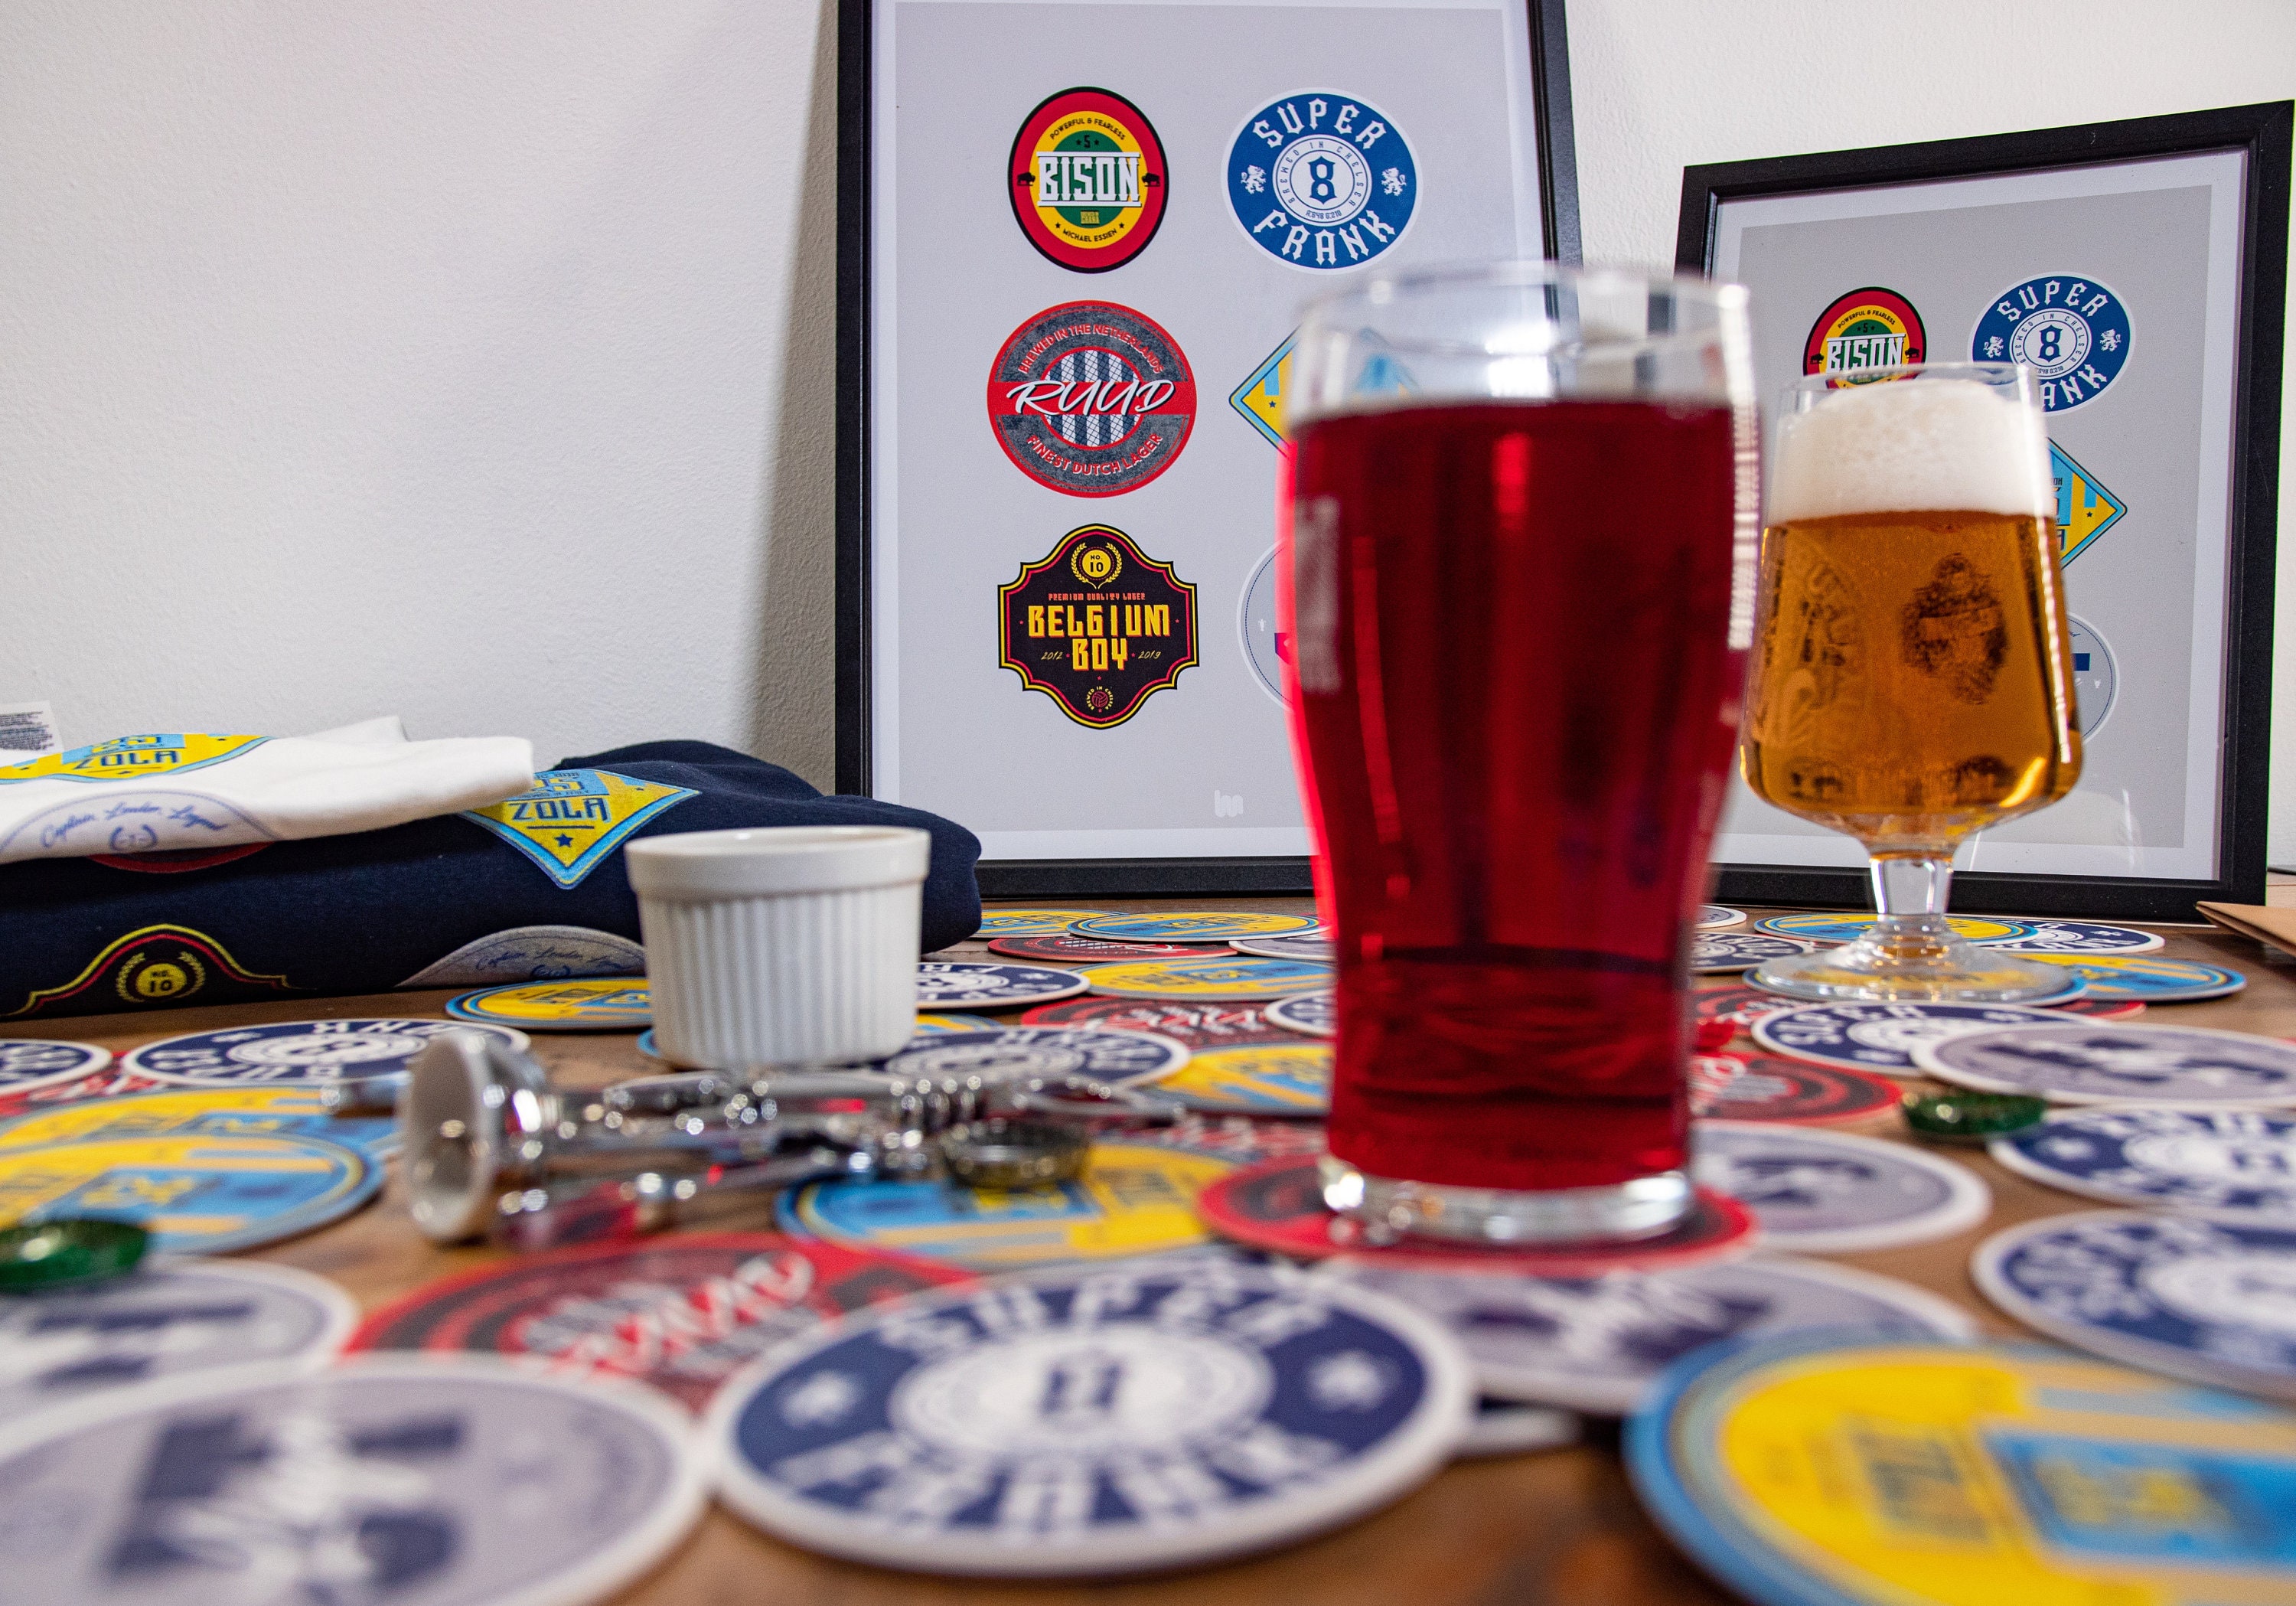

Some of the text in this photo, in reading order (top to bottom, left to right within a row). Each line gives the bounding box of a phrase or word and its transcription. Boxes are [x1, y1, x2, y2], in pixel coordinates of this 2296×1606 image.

[1050, 118, 1085, 140] POWERFUL
[1094, 118, 1125, 140] FEARLESS
[1252, 97, 1387, 149] SUPER
[1084, 135, 1091, 149] 5
[1038, 155, 1140, 202] BISON
[1307, 155, 1338, 204] 8
[1063, 228, 1117, 242] MICHAEL ESSIEN
[1253, 209, 1396, 266] FRANK
[1997, 279, 2108, 322] SUPER
[1838, 310, 1865, 328] POWERFUL
[1872, 309, 1896, 325] FEARLESS
[1863, 323, 1868, 333] 5
[1017, 324, 1164, 374] BREWED IN THE NETHERLANDS
[1826, 337, 1905, 374] BISON
[2037, 325, 2063, 363] 8
[1006, 380, 1176, 416] RUUD
[2040, 364, 2107, 410] ANK
[1026, 433, 1163, 476] FINEST DUTCH LAGER
[1089, 561, 1104, 573] 10
[1048, 592, 1146, 601] PREMIUM QUALITY LAGER
[1028, 604, 1171, 637] BELGIUM
[1041, 651, 1063, 661] 2012
[1072, 638, 1128, 671] BOY
[1138, 651, 1162, 659] 2019
[73, 750, 181, 770] ZOLA
[507, 798, 610, 822] ZOLA
[150, 980, 172, 993] 10
